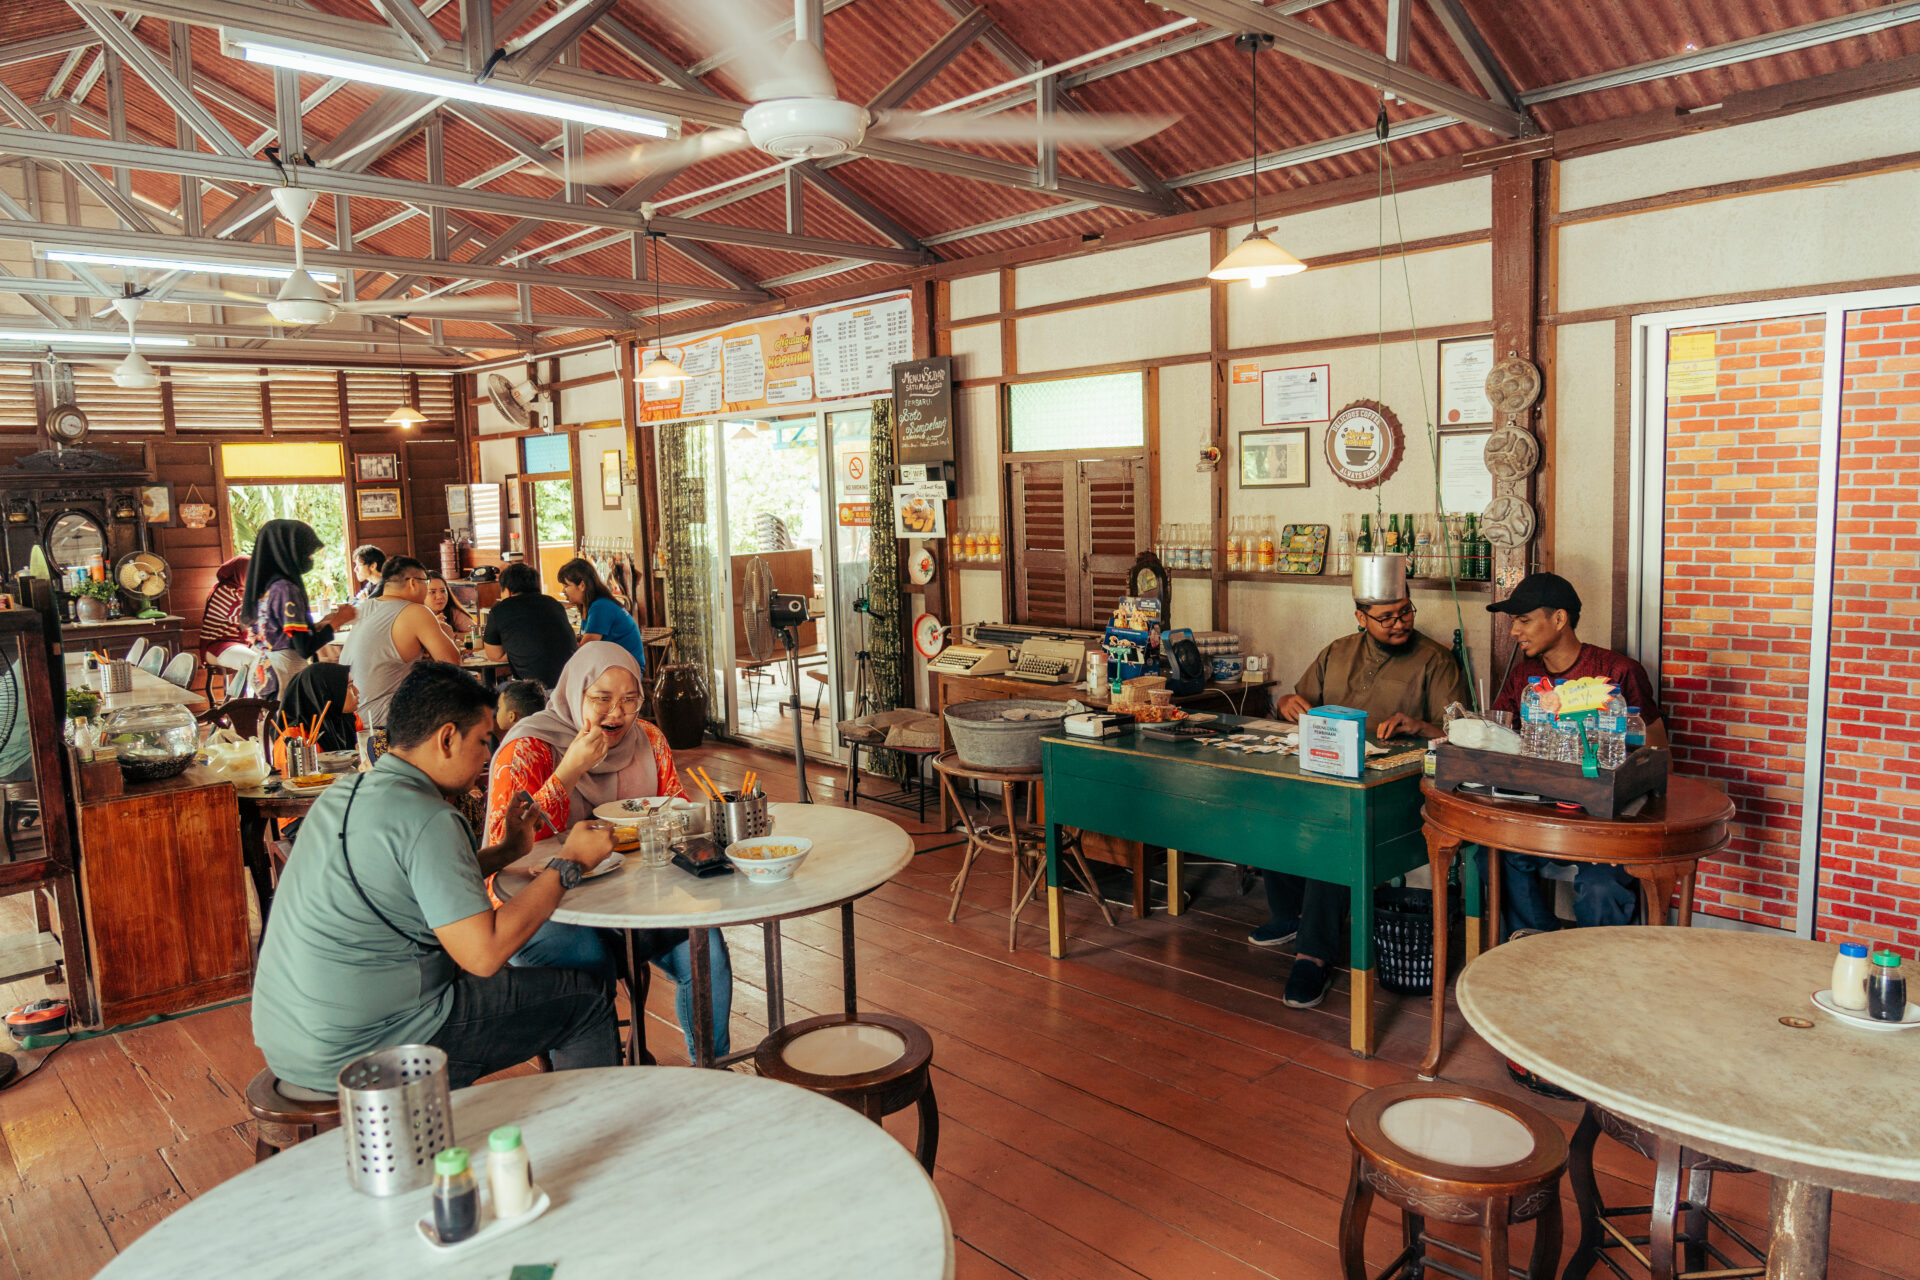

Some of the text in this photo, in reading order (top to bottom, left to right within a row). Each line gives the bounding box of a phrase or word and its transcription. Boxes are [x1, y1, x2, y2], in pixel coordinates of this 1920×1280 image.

[768, 351, 811, 369] KOPITIAM
[902, 371, 922, 384] MENU
[1332, 410, 1360, 433] DELICIOUS
[1340, 467, 1362, 478] ALWAYS
